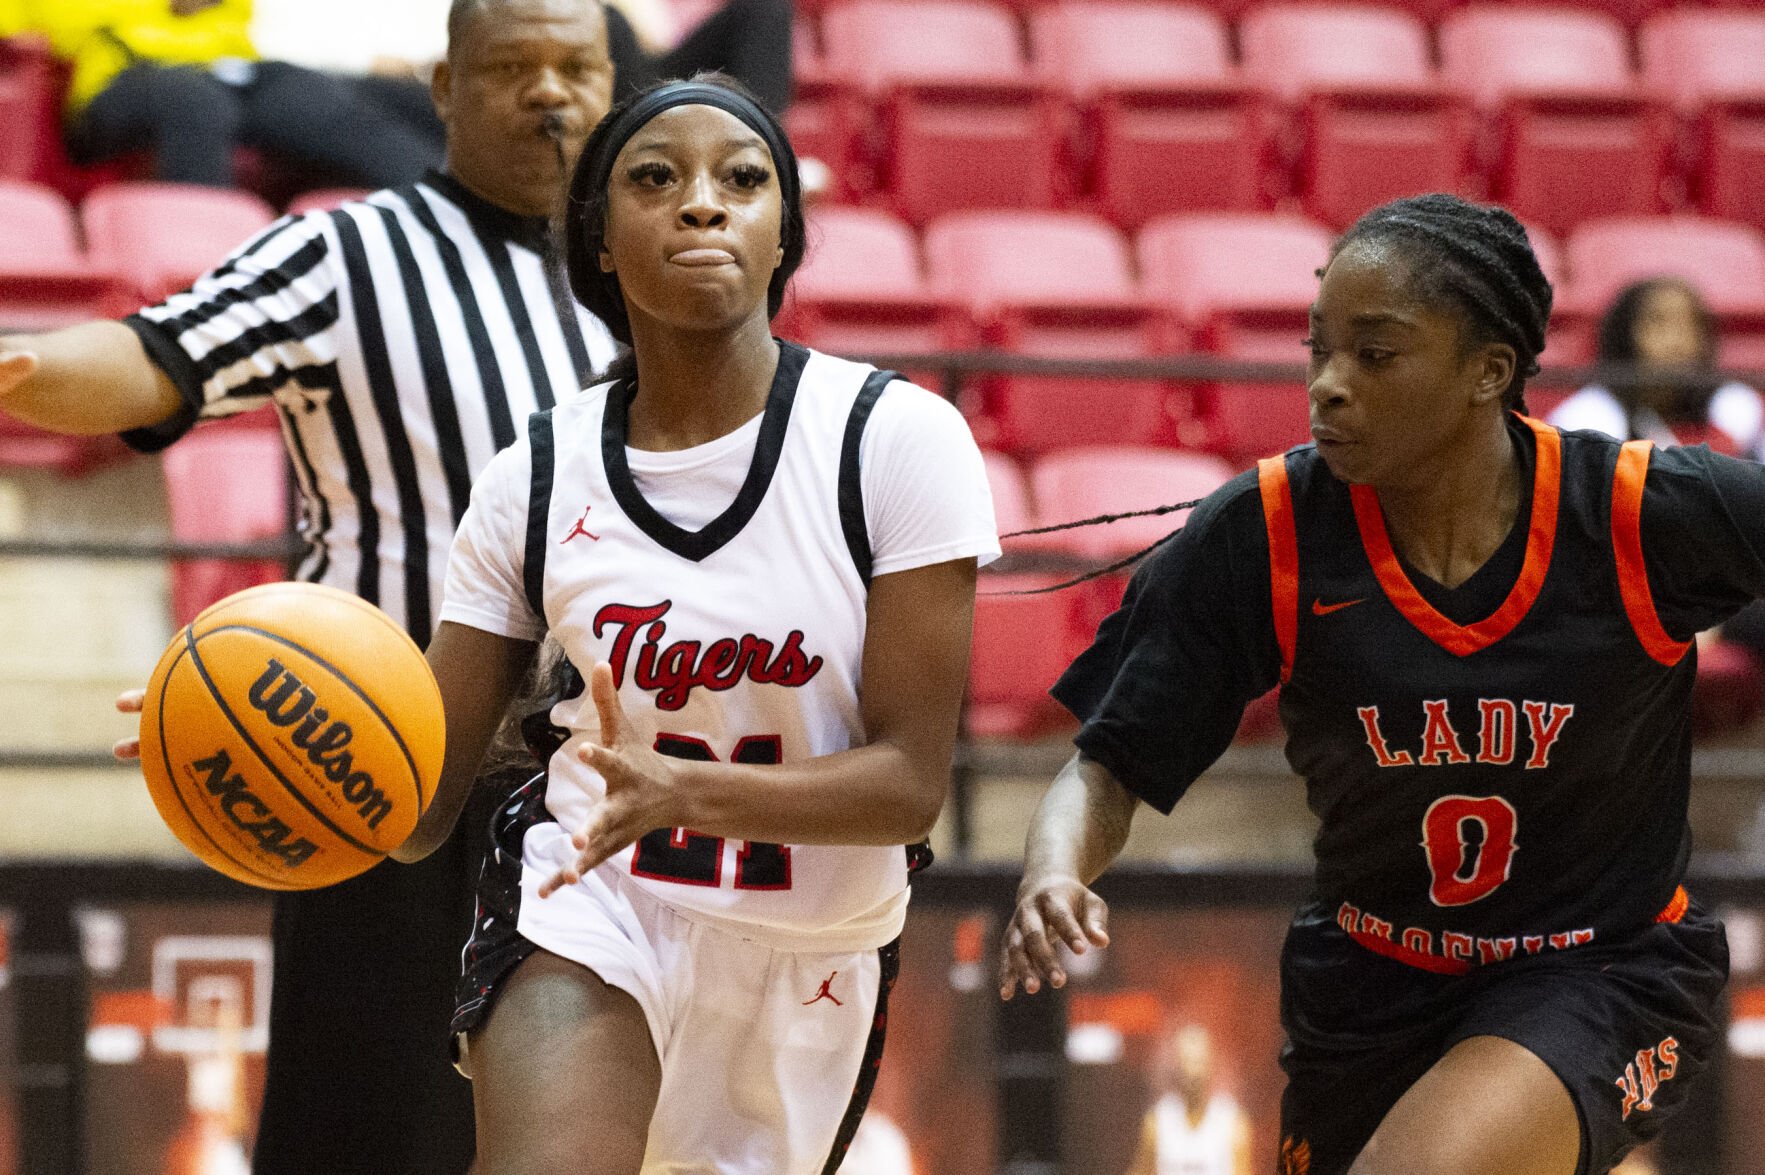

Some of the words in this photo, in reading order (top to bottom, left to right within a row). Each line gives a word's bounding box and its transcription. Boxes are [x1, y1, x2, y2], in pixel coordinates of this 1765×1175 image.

[593, 599, 823, 711] Tigers
[248, 658, 393, 831] Wilson
[1357, 698, 1575, 769] LADY
[191, 747, 320, 869] NCAA
[1418, 794, 1520, 907] 0
